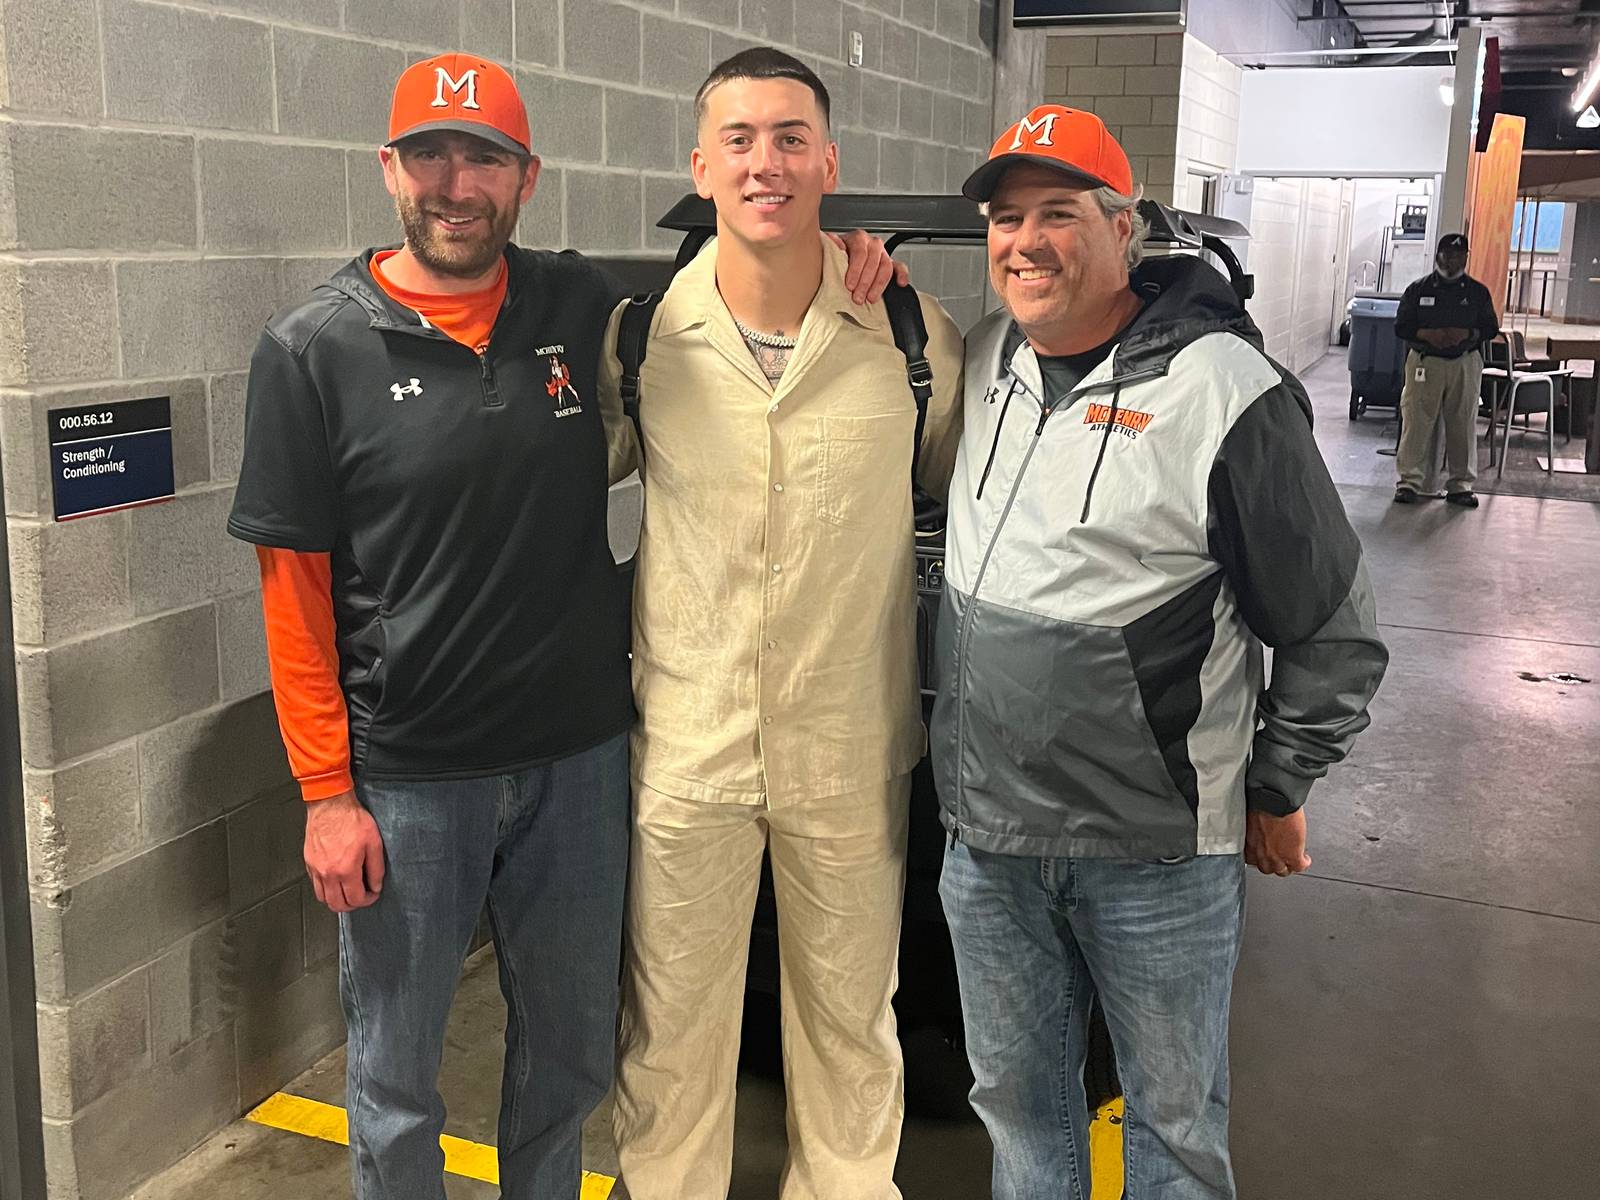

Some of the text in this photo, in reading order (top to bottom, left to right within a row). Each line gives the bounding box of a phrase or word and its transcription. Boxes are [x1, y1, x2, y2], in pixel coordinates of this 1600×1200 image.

[431, 66, 481, 110] M
[1008, 113, 1060, 151] M
[59, 411, 114, 430] 000.56.12
[62, 446, 106, 464] Strength
[63, 459, 126, 480] Conditioning
